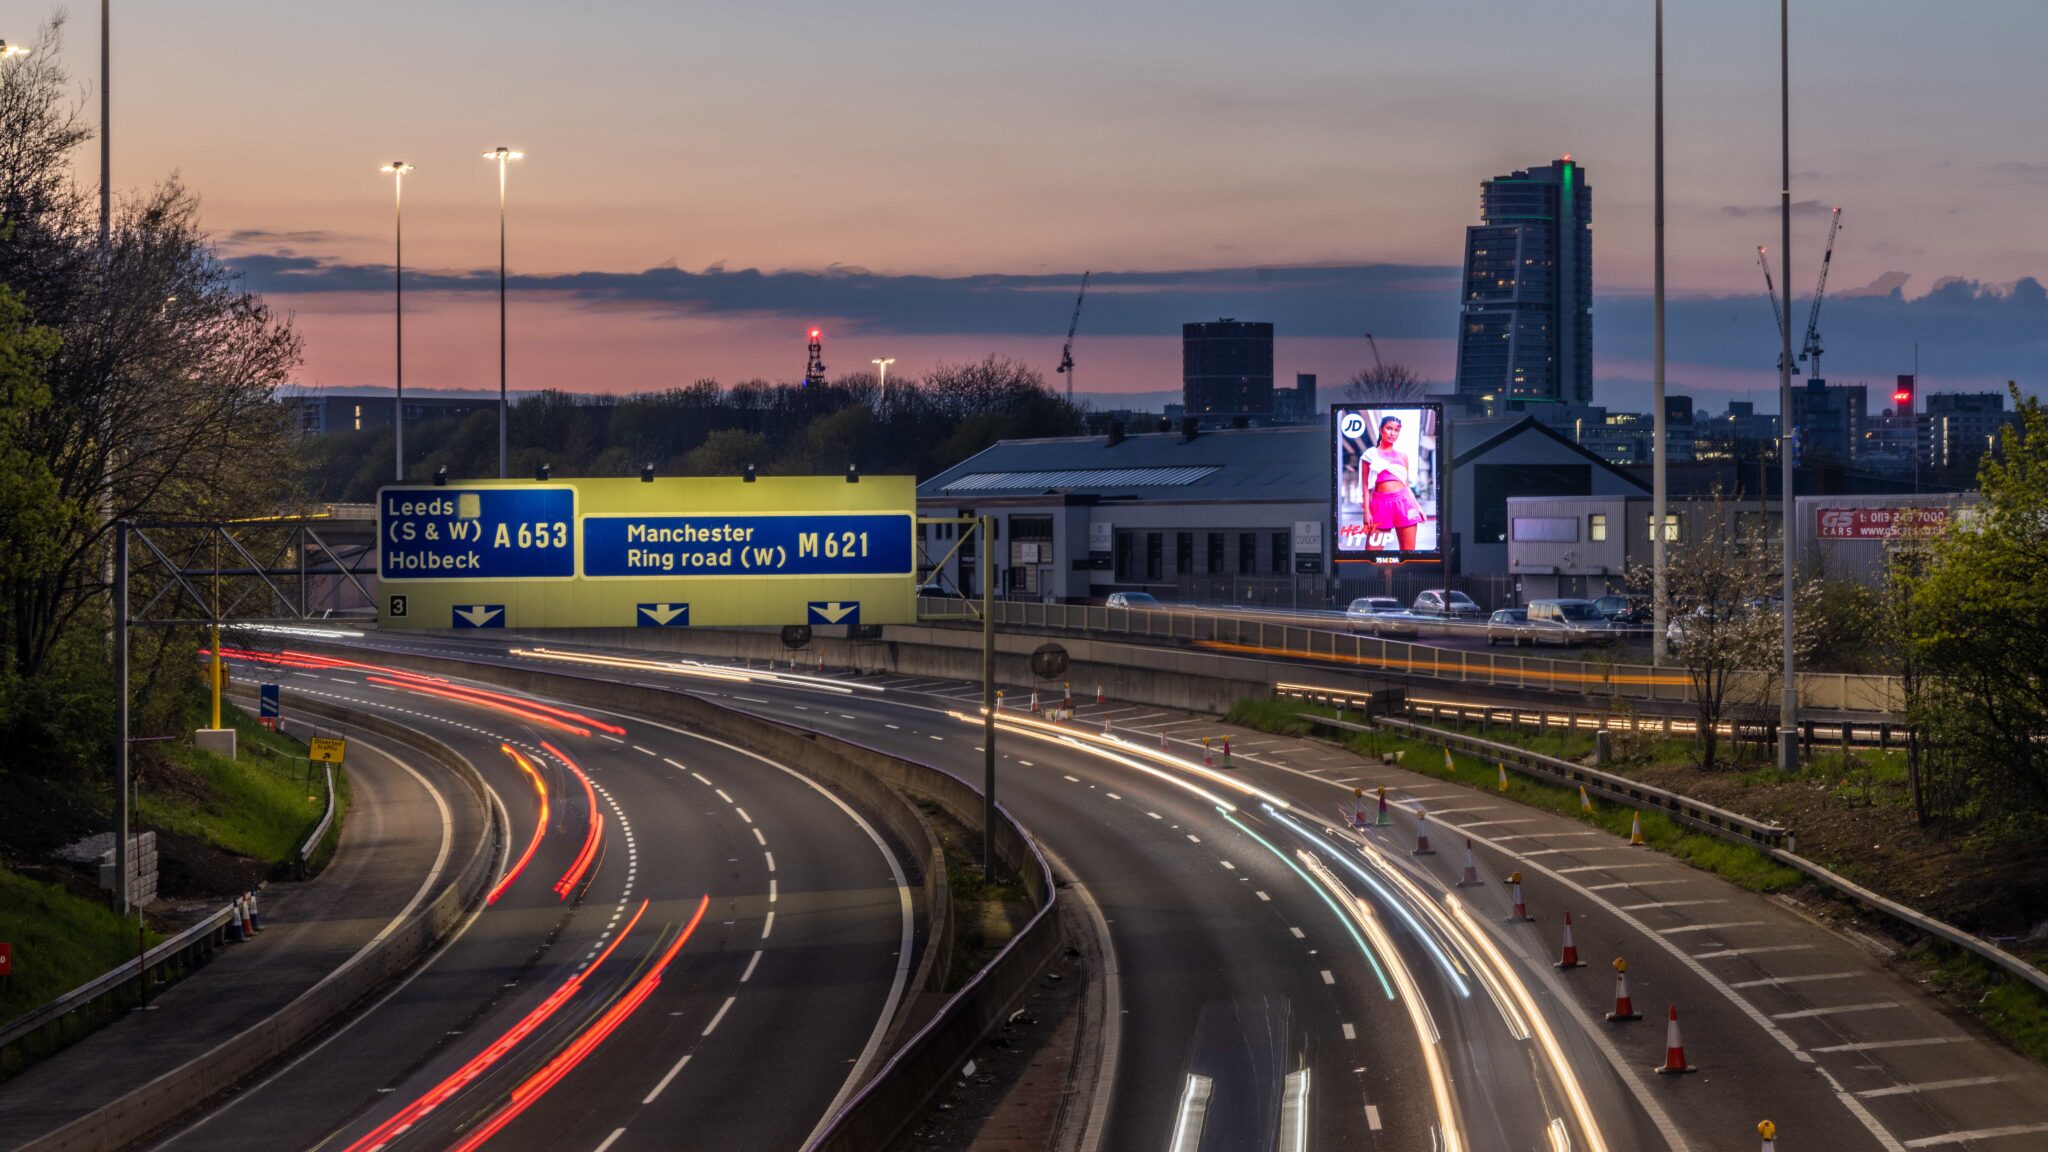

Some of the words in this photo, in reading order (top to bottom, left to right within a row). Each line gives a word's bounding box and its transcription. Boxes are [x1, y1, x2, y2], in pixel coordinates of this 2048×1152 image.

[1345, 420, 1362, 432] JD
[389, 497, 454, 516] Leeds
[1822, 512, 1854, 527] G5
[1871, 512, 1889, 522] 0113
[1917, 512, 1945, 522] 7000
[389, 520, 416, 543] (S
[425, 523, 439, 541] &
[449, 520, 482, 543] W)
[493, 523, 511, 548] A
[517, 522, 567, 549] 653
[627, 523, 754, 543] Manchester
[1822, 527, 1853, 536] CARS
[798, 532, 818, 558] M
[824, 532, 868, 559] 621
[1296, 535, 1320, 545] CONSORT
[1346, 532, 1366, 547] IT
[1369, 532, 1395, 547] UP
[389, 551, 480, 569] Holbeck
[627, 549, 674, 571] Ring
[681, 548, 731, 567] road
[740, 546, 786, 569] (W)
[393, 599, 404, 614] 3
[315, 738, 342, 746] Diverted
